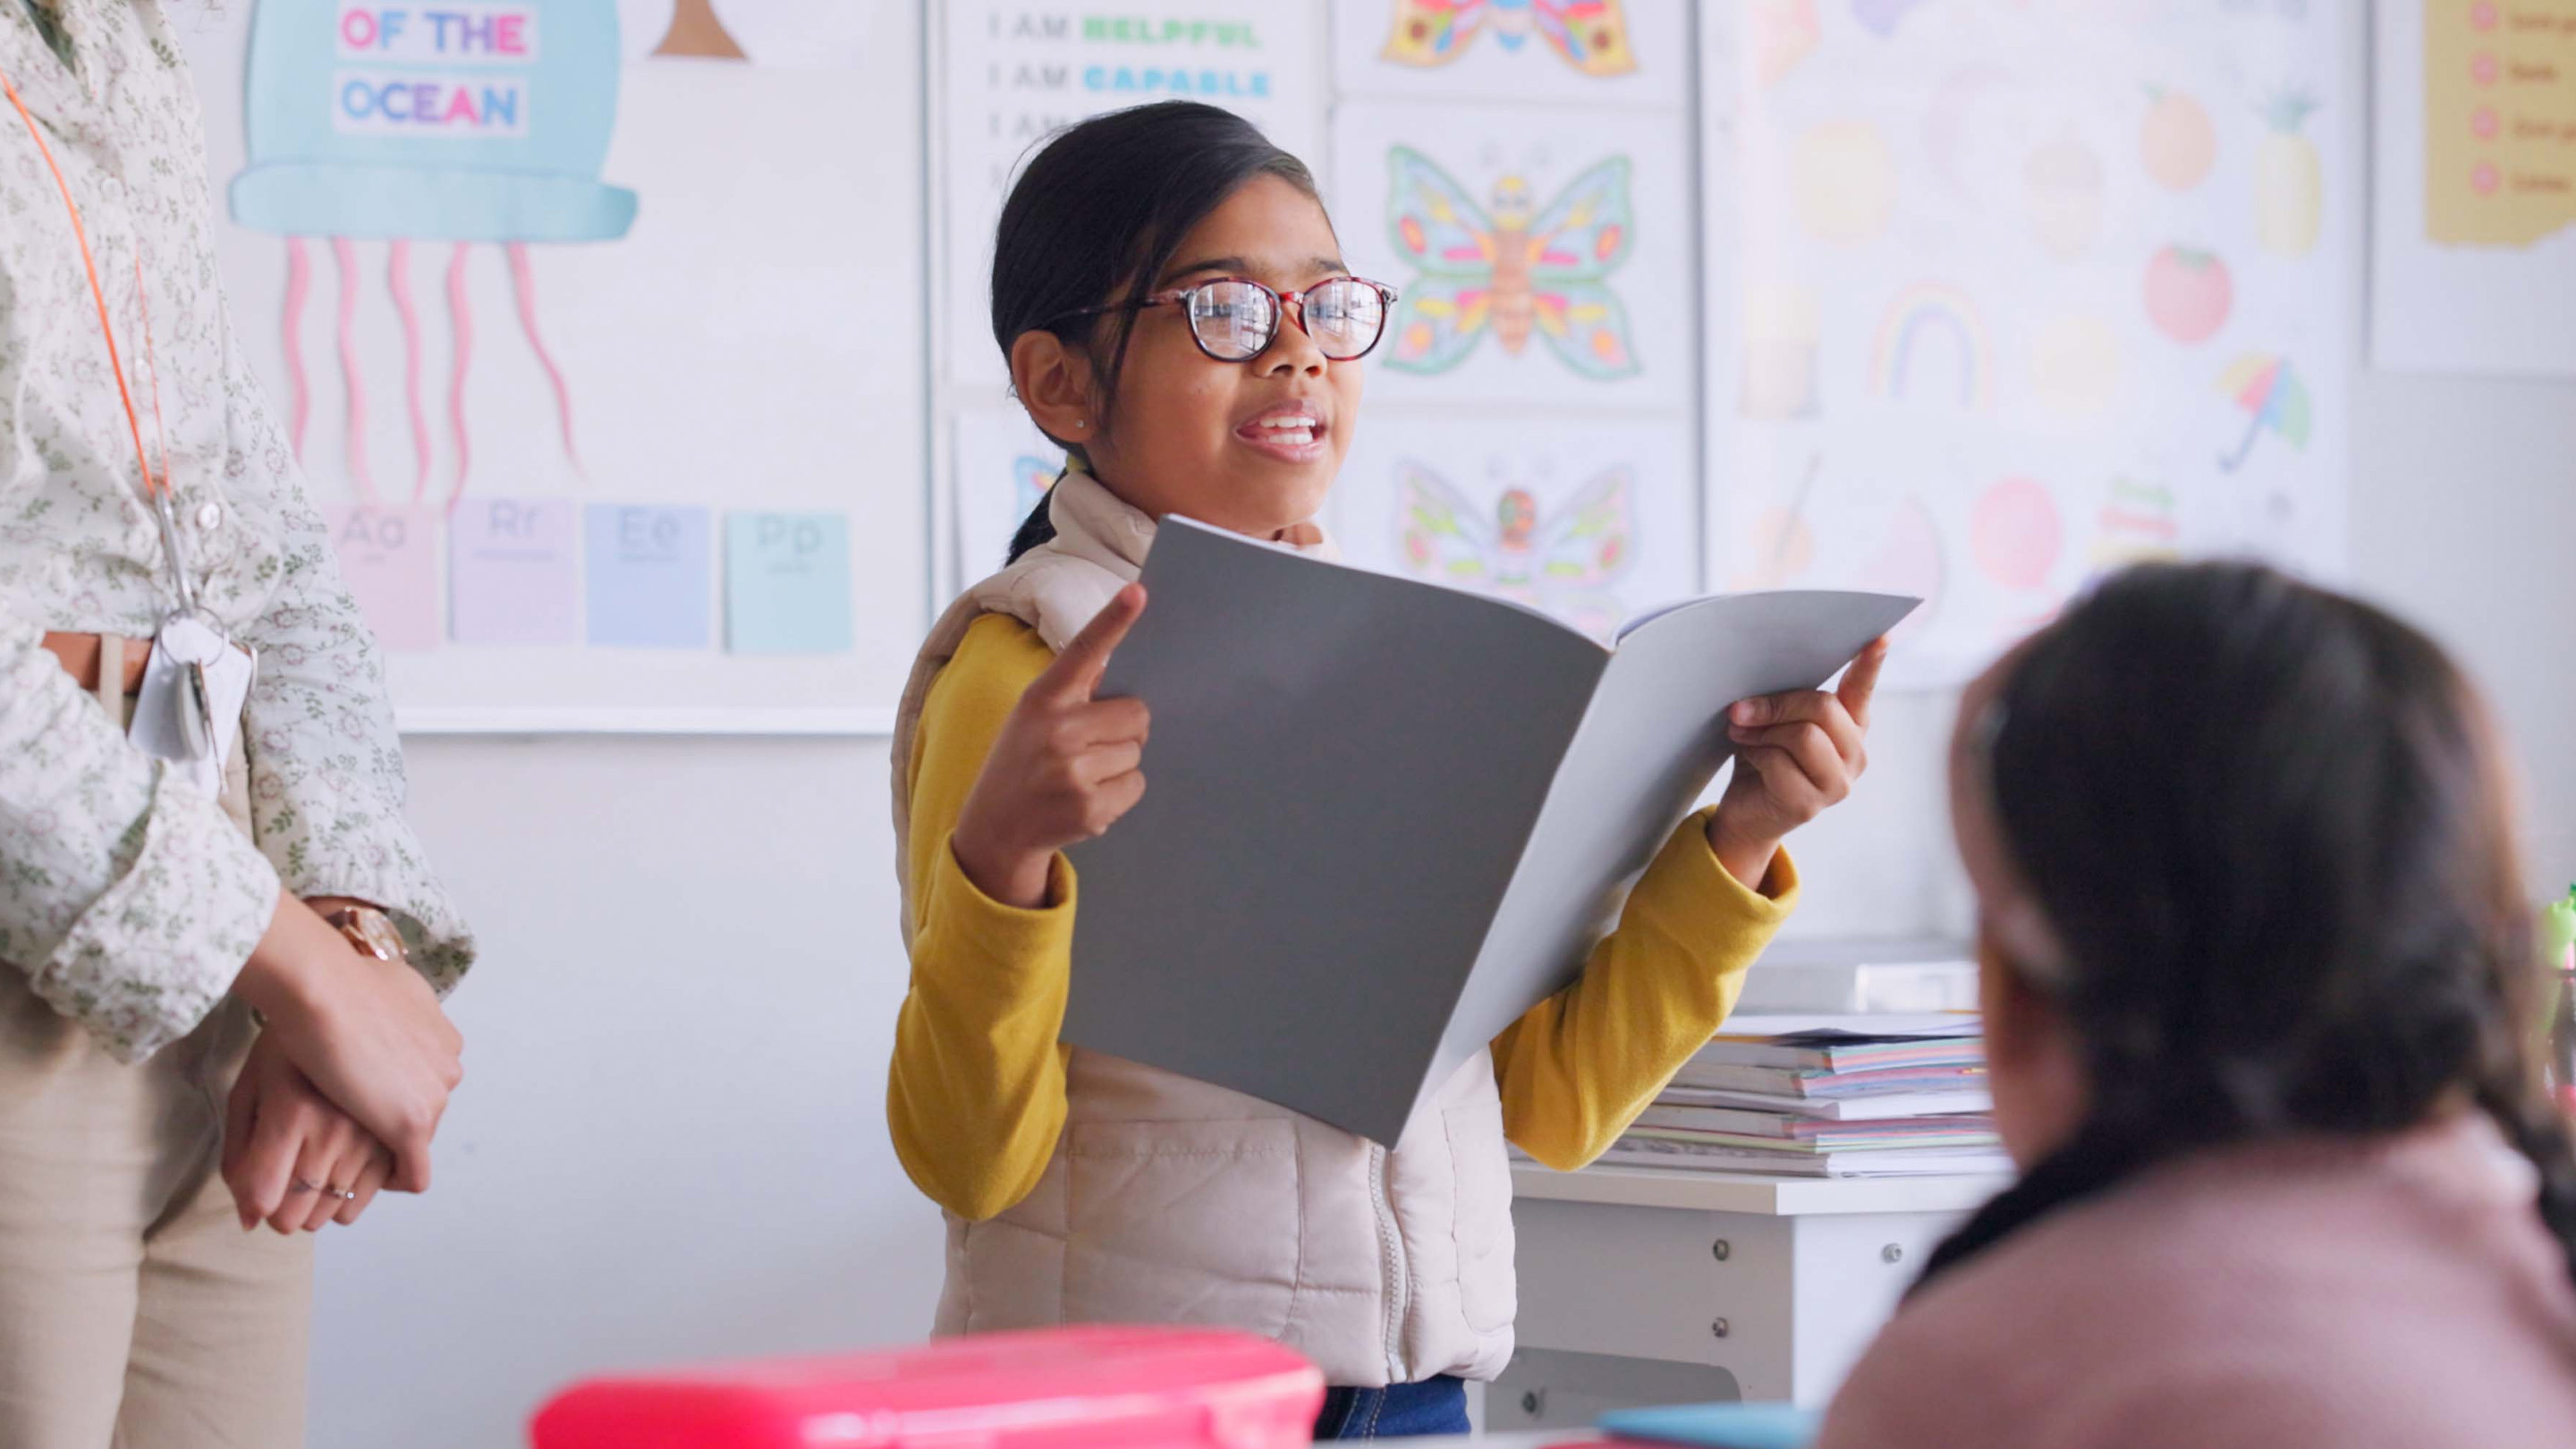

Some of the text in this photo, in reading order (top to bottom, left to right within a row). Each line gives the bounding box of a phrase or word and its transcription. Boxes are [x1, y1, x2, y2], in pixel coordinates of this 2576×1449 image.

[341, 8, 528, 55] OF THE
[988, 12, 1264, 49] I AM HELPFUL
[988, 62, 1269, 97] I AM CAPABLE
[342, 80, 517, 125] OCEAN
[488, 500, 542, 538] Rr
[618, 508, 682, 548] Ee
